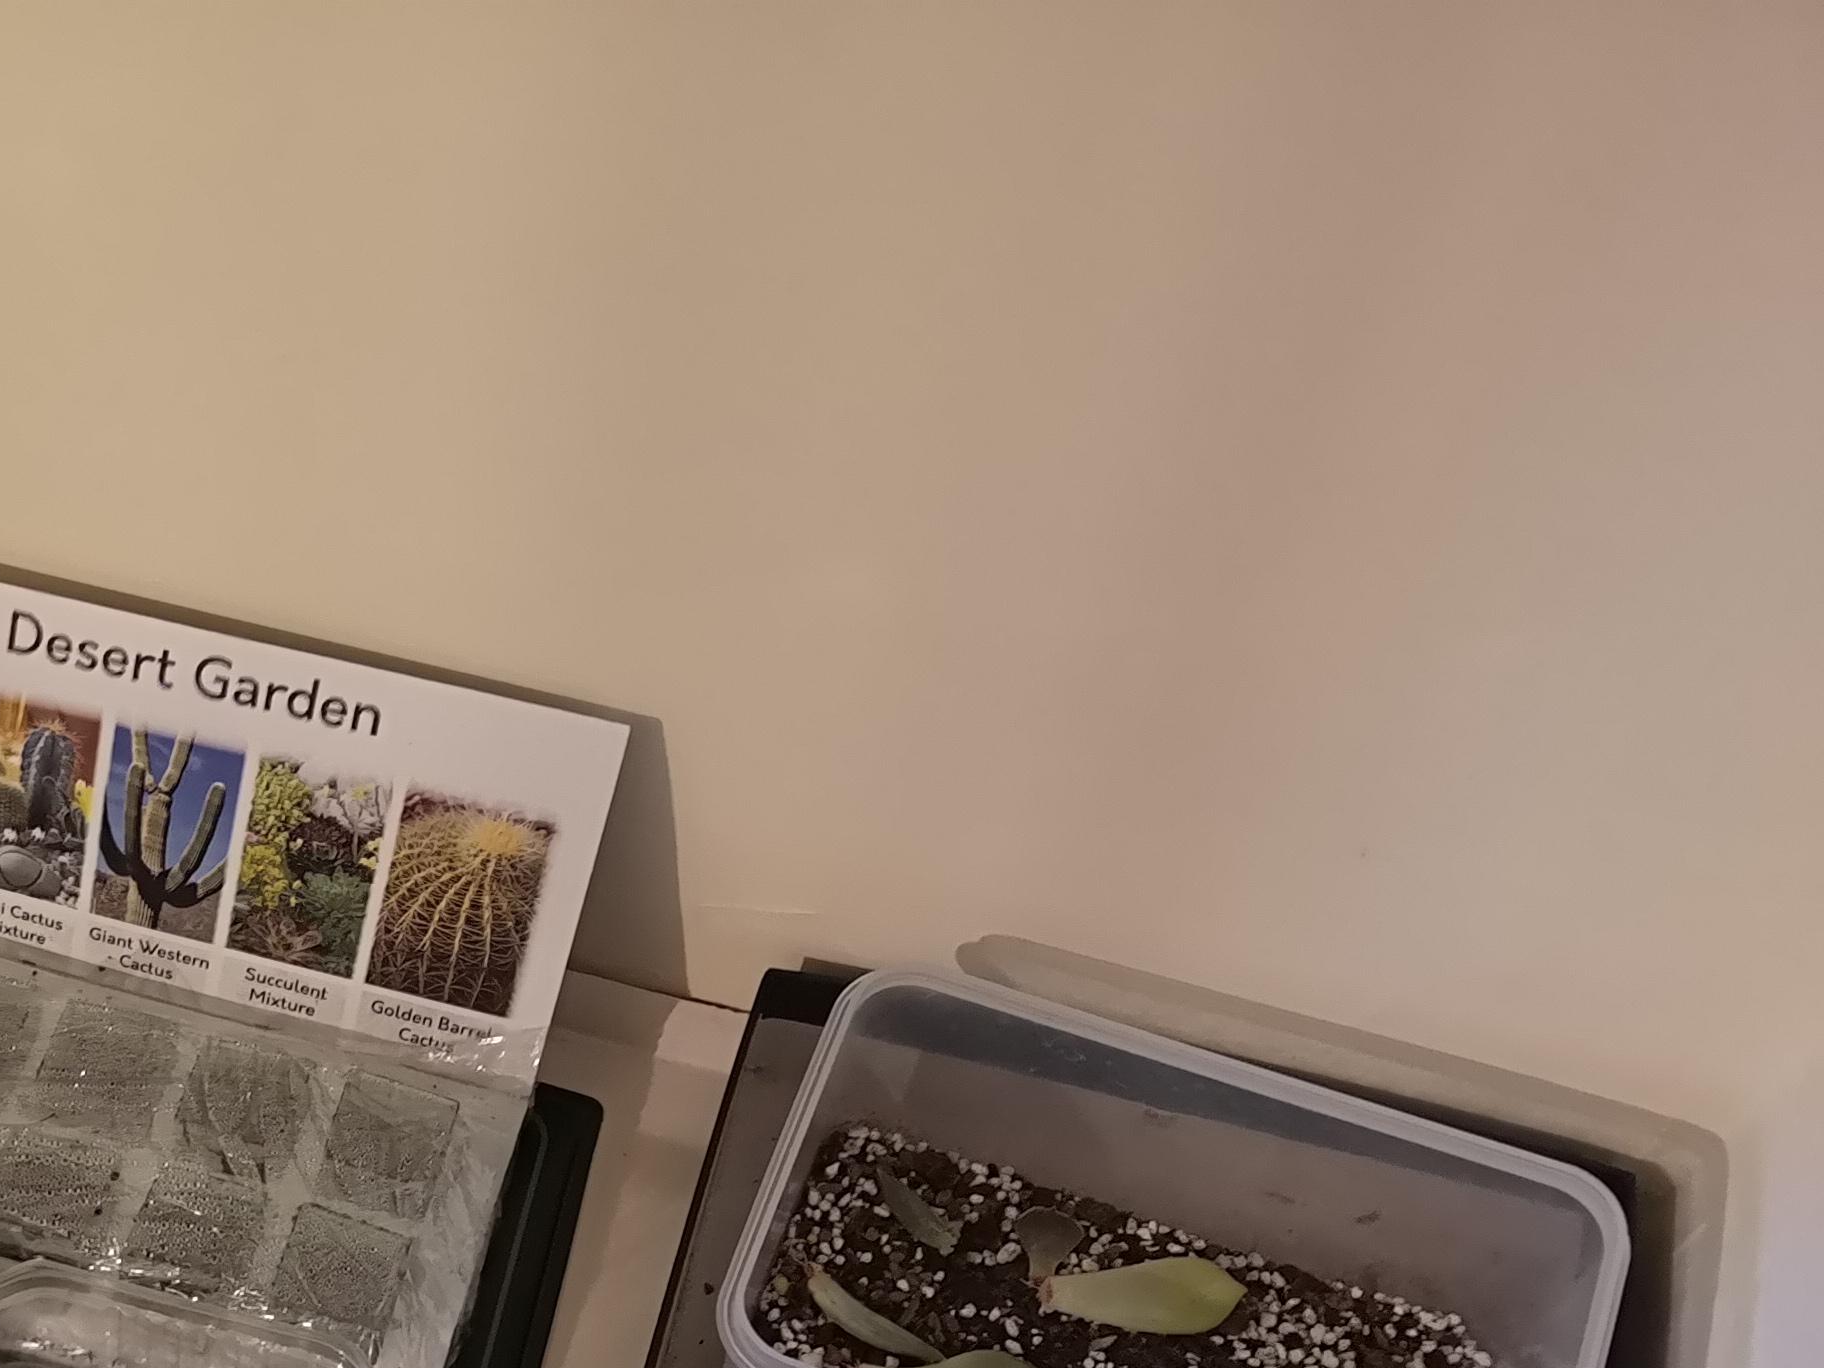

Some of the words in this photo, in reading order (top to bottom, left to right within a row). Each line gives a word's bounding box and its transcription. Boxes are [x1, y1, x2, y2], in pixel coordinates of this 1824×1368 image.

[6, 608, 176, 690] Desert
[194, 655, 383, 737] Garden
[10, 905, 64, 931] Cactus
[88, 927, 134, 951] Giant
[139, 939, 210, 970] Western
[119, 954, 174, 980] Cactus
[244, 966, 329, 1001] Succulent
[248, 988, 316, 1017] Mixture
[370, 999, 433, 1028] Golden
[437, 1015, 493, 1039] Barrel
[398, 1027, 454, 1053] Cactus
